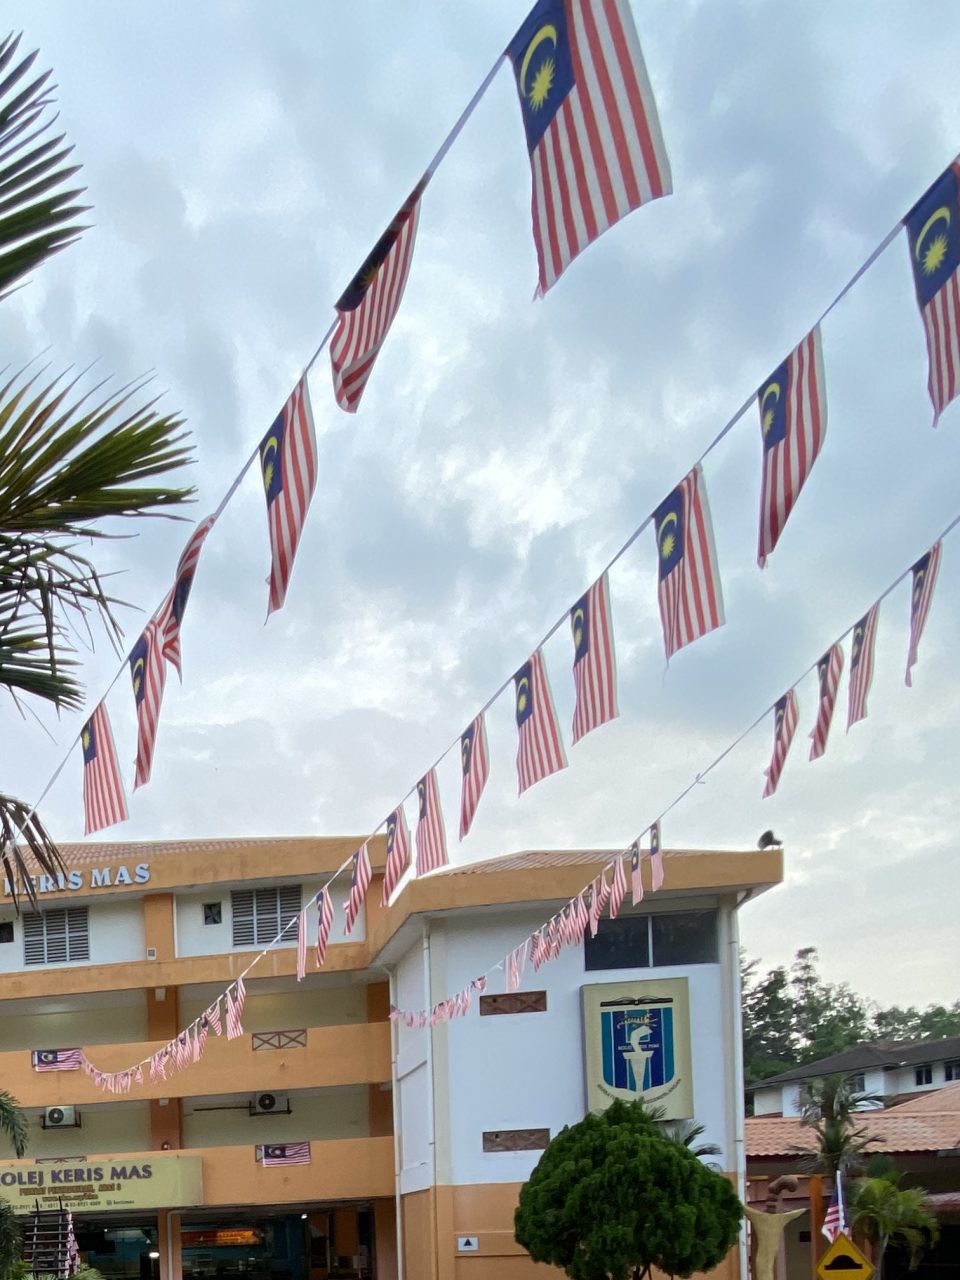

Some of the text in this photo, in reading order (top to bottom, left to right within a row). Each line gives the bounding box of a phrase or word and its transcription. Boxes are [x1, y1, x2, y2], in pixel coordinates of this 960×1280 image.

[89, 862, 151, 890] MAS
[51, 1167, 103, 1184] KERIS
[110, 1164, 152, 1180] MAS
